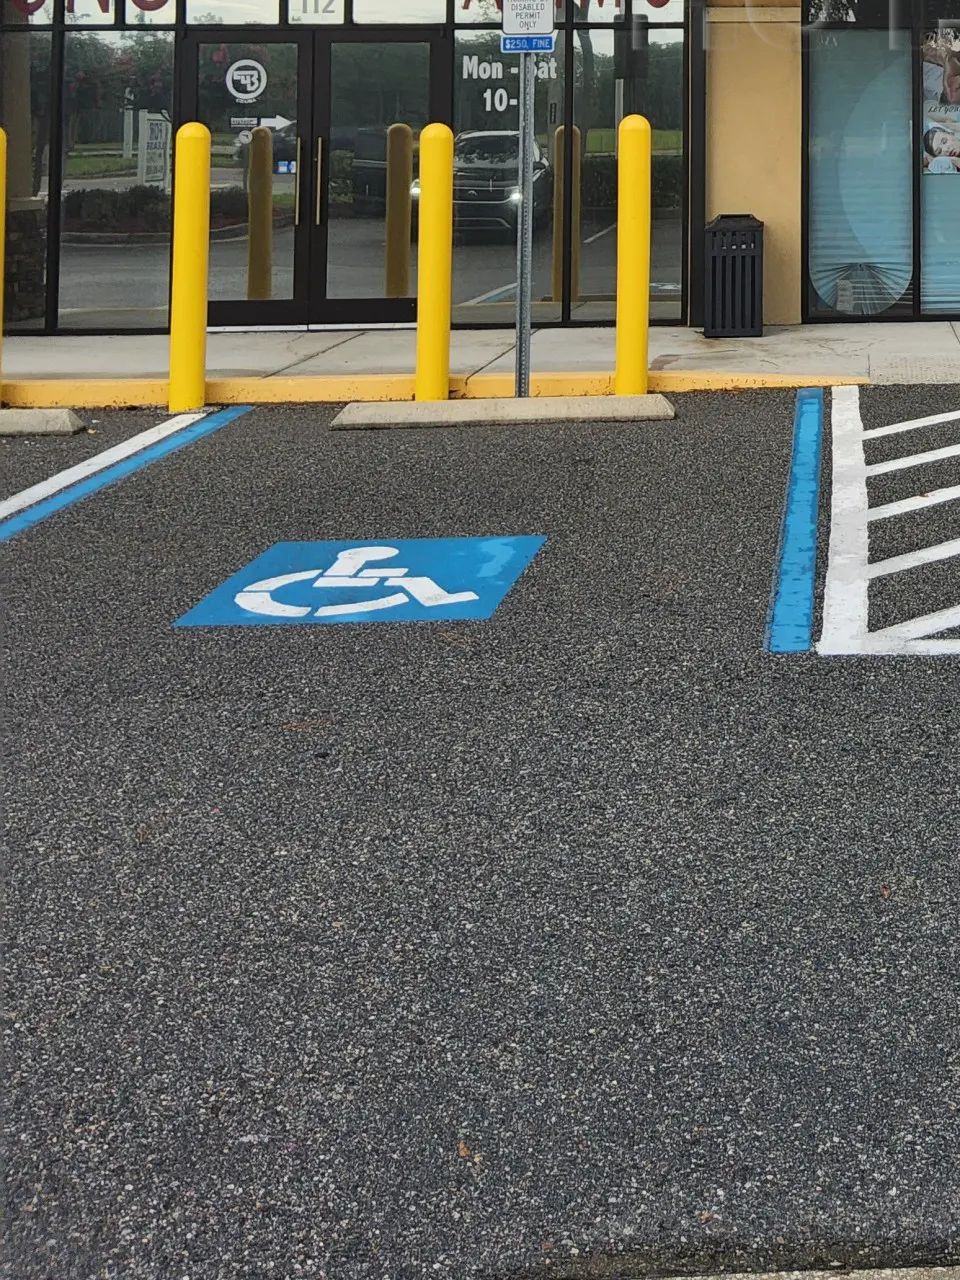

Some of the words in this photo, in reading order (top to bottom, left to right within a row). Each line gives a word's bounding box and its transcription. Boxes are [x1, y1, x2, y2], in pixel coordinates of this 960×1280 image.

[511, 2, 546, 11] DISABLED
[515, 11, 541, 20] PERMIT
[519, 20, 537, 29] ONLY
[532, 38, 551, 49] FINE
[462, 55, 503, 79] Mon
[483, 88, 518, 111] 10-
